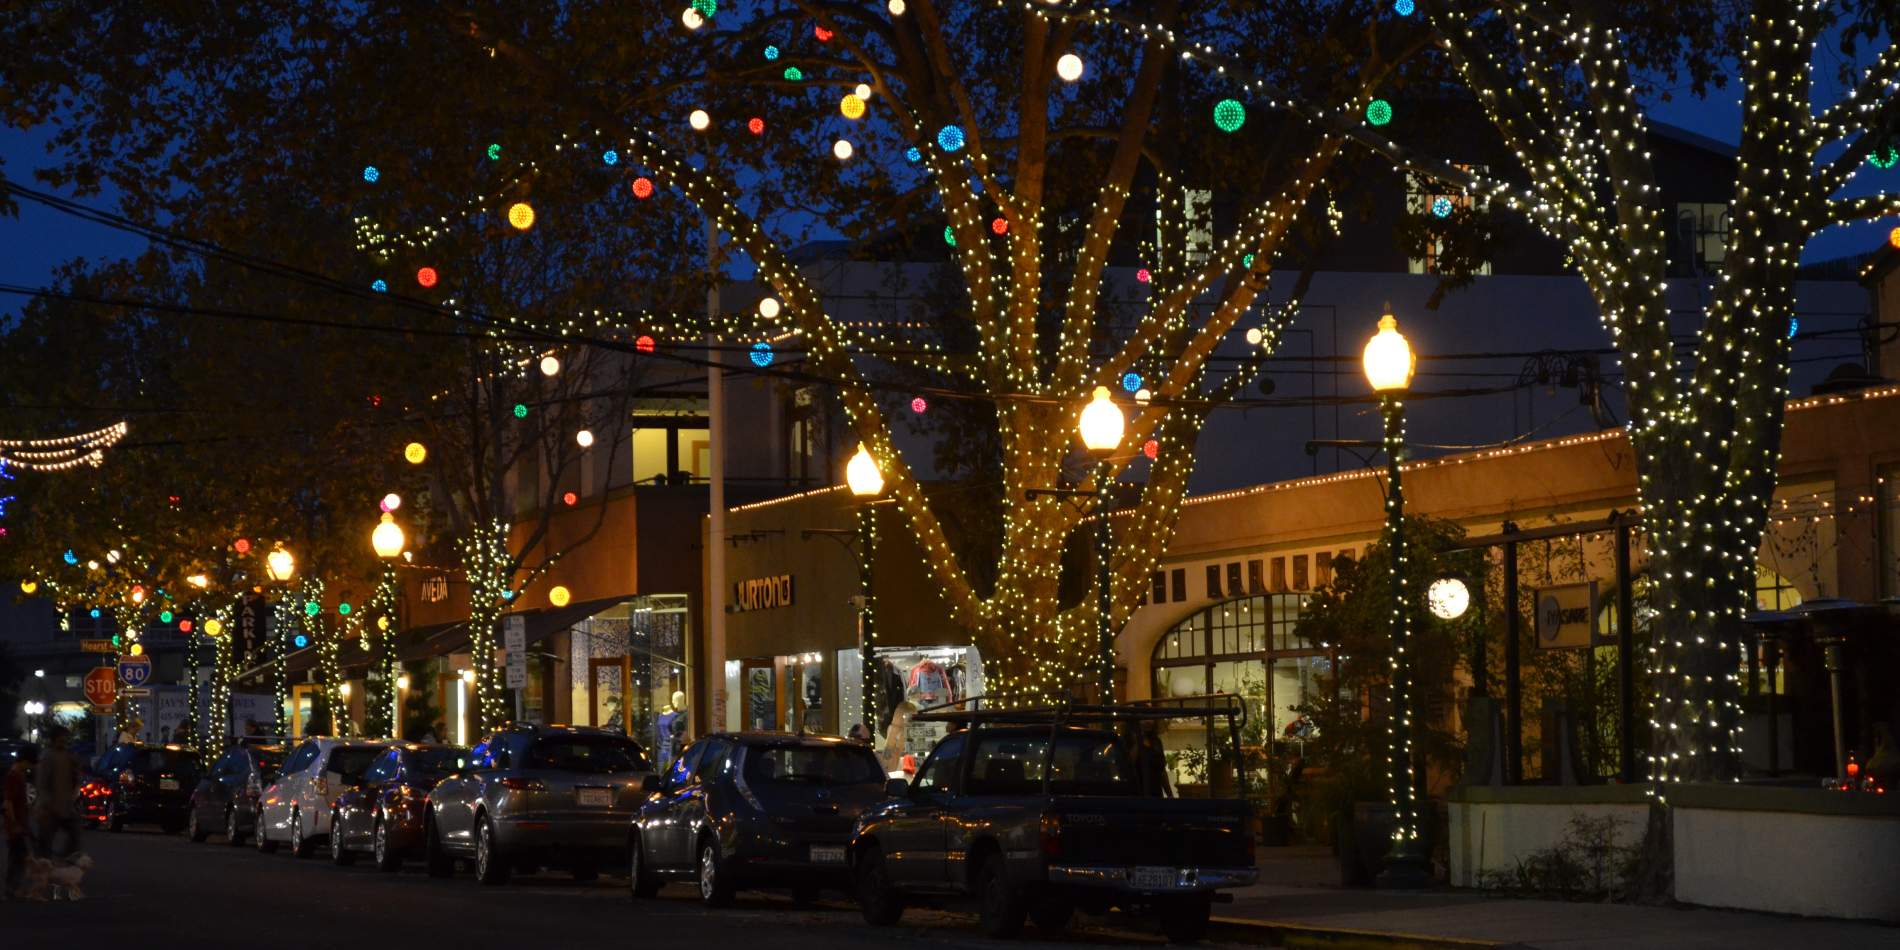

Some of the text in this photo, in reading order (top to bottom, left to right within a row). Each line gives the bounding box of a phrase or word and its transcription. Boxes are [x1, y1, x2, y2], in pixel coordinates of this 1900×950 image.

[421, 576, 448, 602] AVEDA
[82, 639, 108, 651] Hearst
[125, 668, 144, 681] 80
[86, 679, 116, 694] STO
